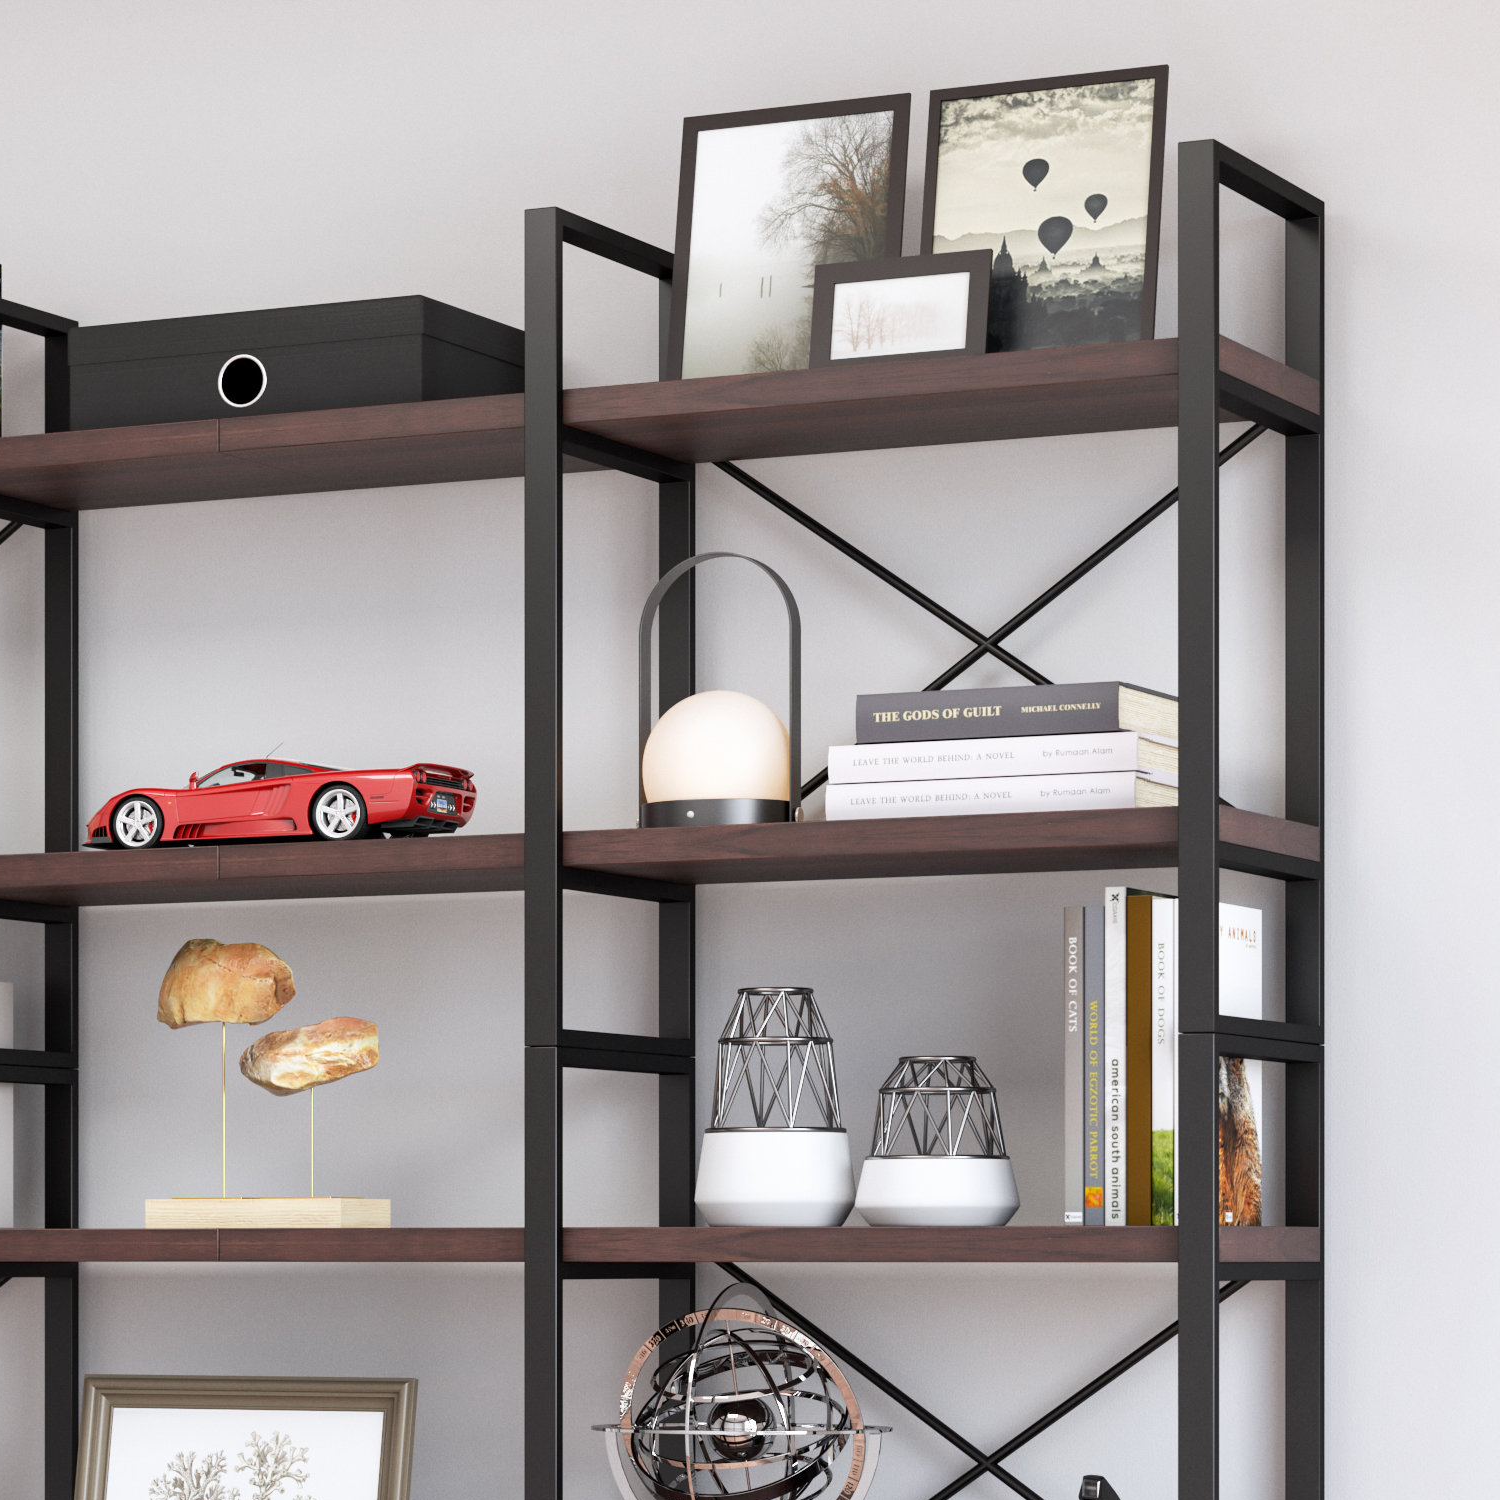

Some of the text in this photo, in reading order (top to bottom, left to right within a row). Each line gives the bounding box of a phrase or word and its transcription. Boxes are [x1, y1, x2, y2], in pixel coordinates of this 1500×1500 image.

[873, 705, 1002, 723] THE GODS OF GUILT
[1021, 701, 1101, 714] MICHAEL CONNELLY
[852, 758, 877, 767] LEAVE
[880, 757, 898, 765] THE
[902, 755, 935, 764] WORLD
[937, 754, 974, 763] BEHIND:
[986, 751, 1015, 760] NOVEL
[1042, 746, 1113, 758] by Rumaan Alam
[1228, 926, 1257, 943] ANIMALS
[1068, 937, 1078, 1032] BOOK OF CATS
[1157, 943, 1165, 1044] BOOK OF DOGS
[1089, 1000, 1099, 1178] WORLD OF EGZOTIC PARROT
[1111, 1059, 1119, 1220] american south animals
